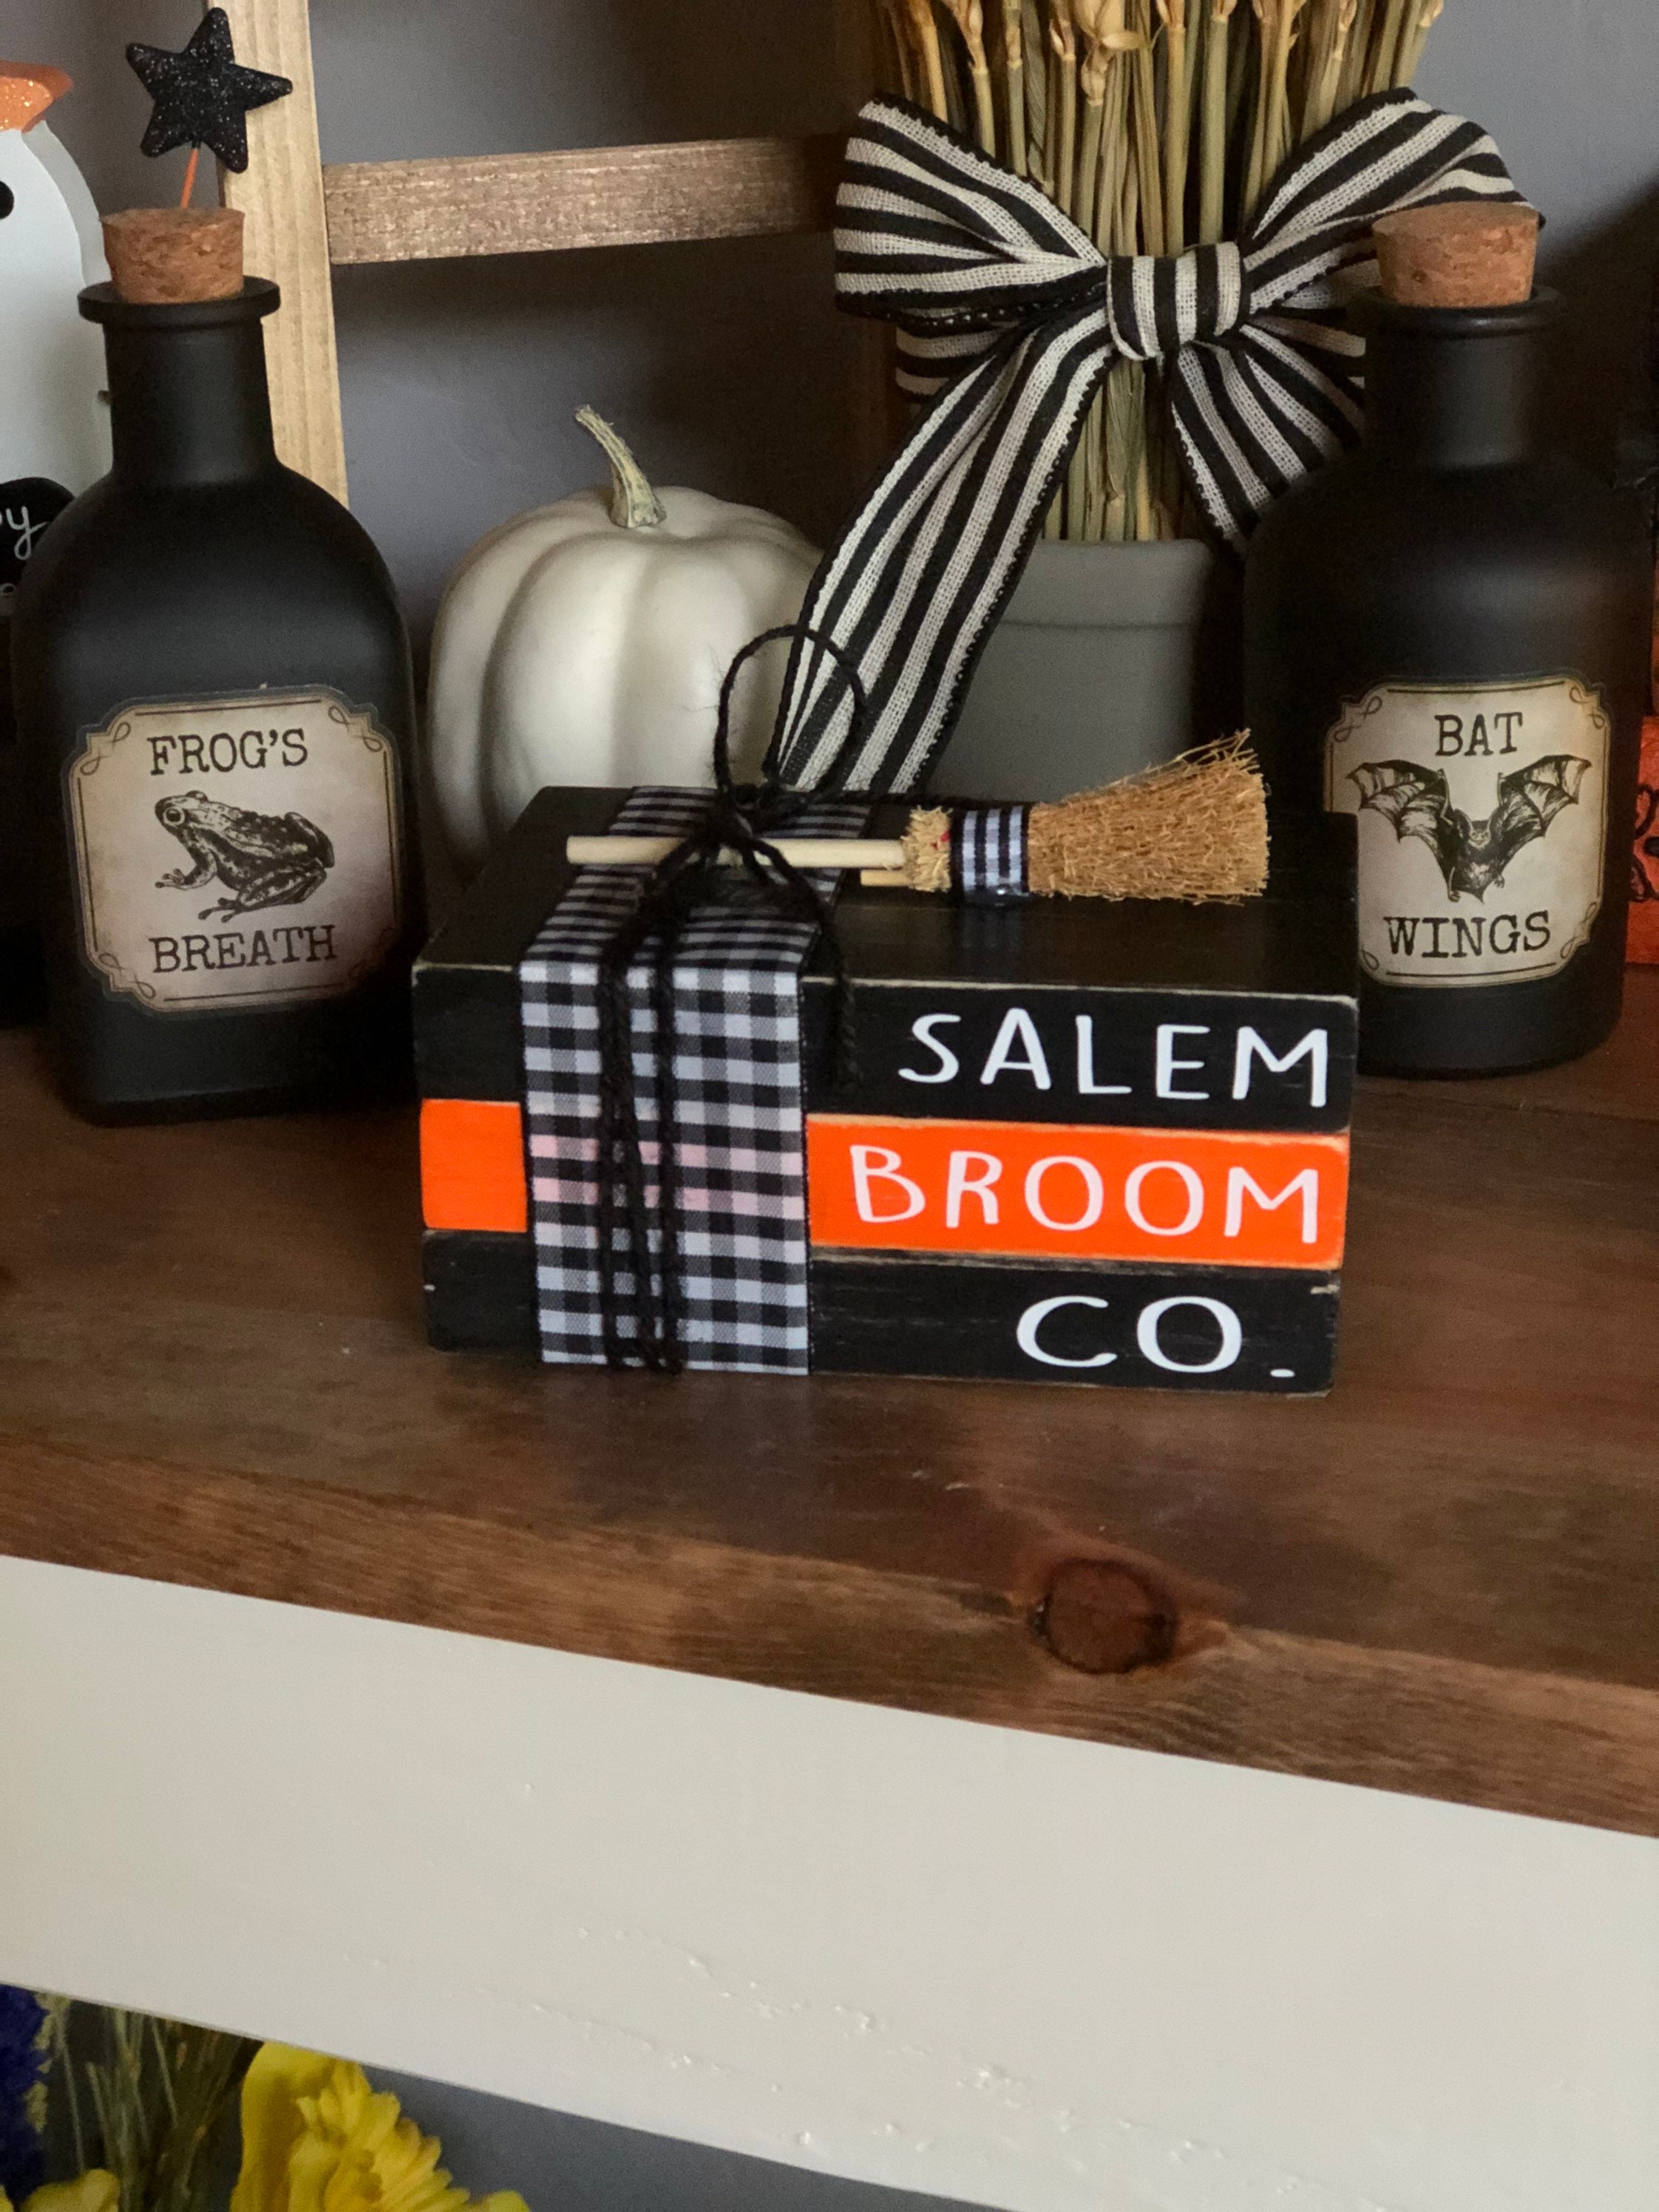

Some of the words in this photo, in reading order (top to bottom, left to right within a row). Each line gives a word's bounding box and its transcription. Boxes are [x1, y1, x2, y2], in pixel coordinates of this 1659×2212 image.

[146, 728, 308, 776] FROG'S
[1434, 711, 1523, 756] BAT
[149, 924, 336, 973] BREATH
[1383, 910, 1550, 958] WINGS
[898, 1008, 1329, 1107] SALEM
[849, 1144, 1319, 1244] BROOM
[1016, 1295, 1295, 1378] CO.
